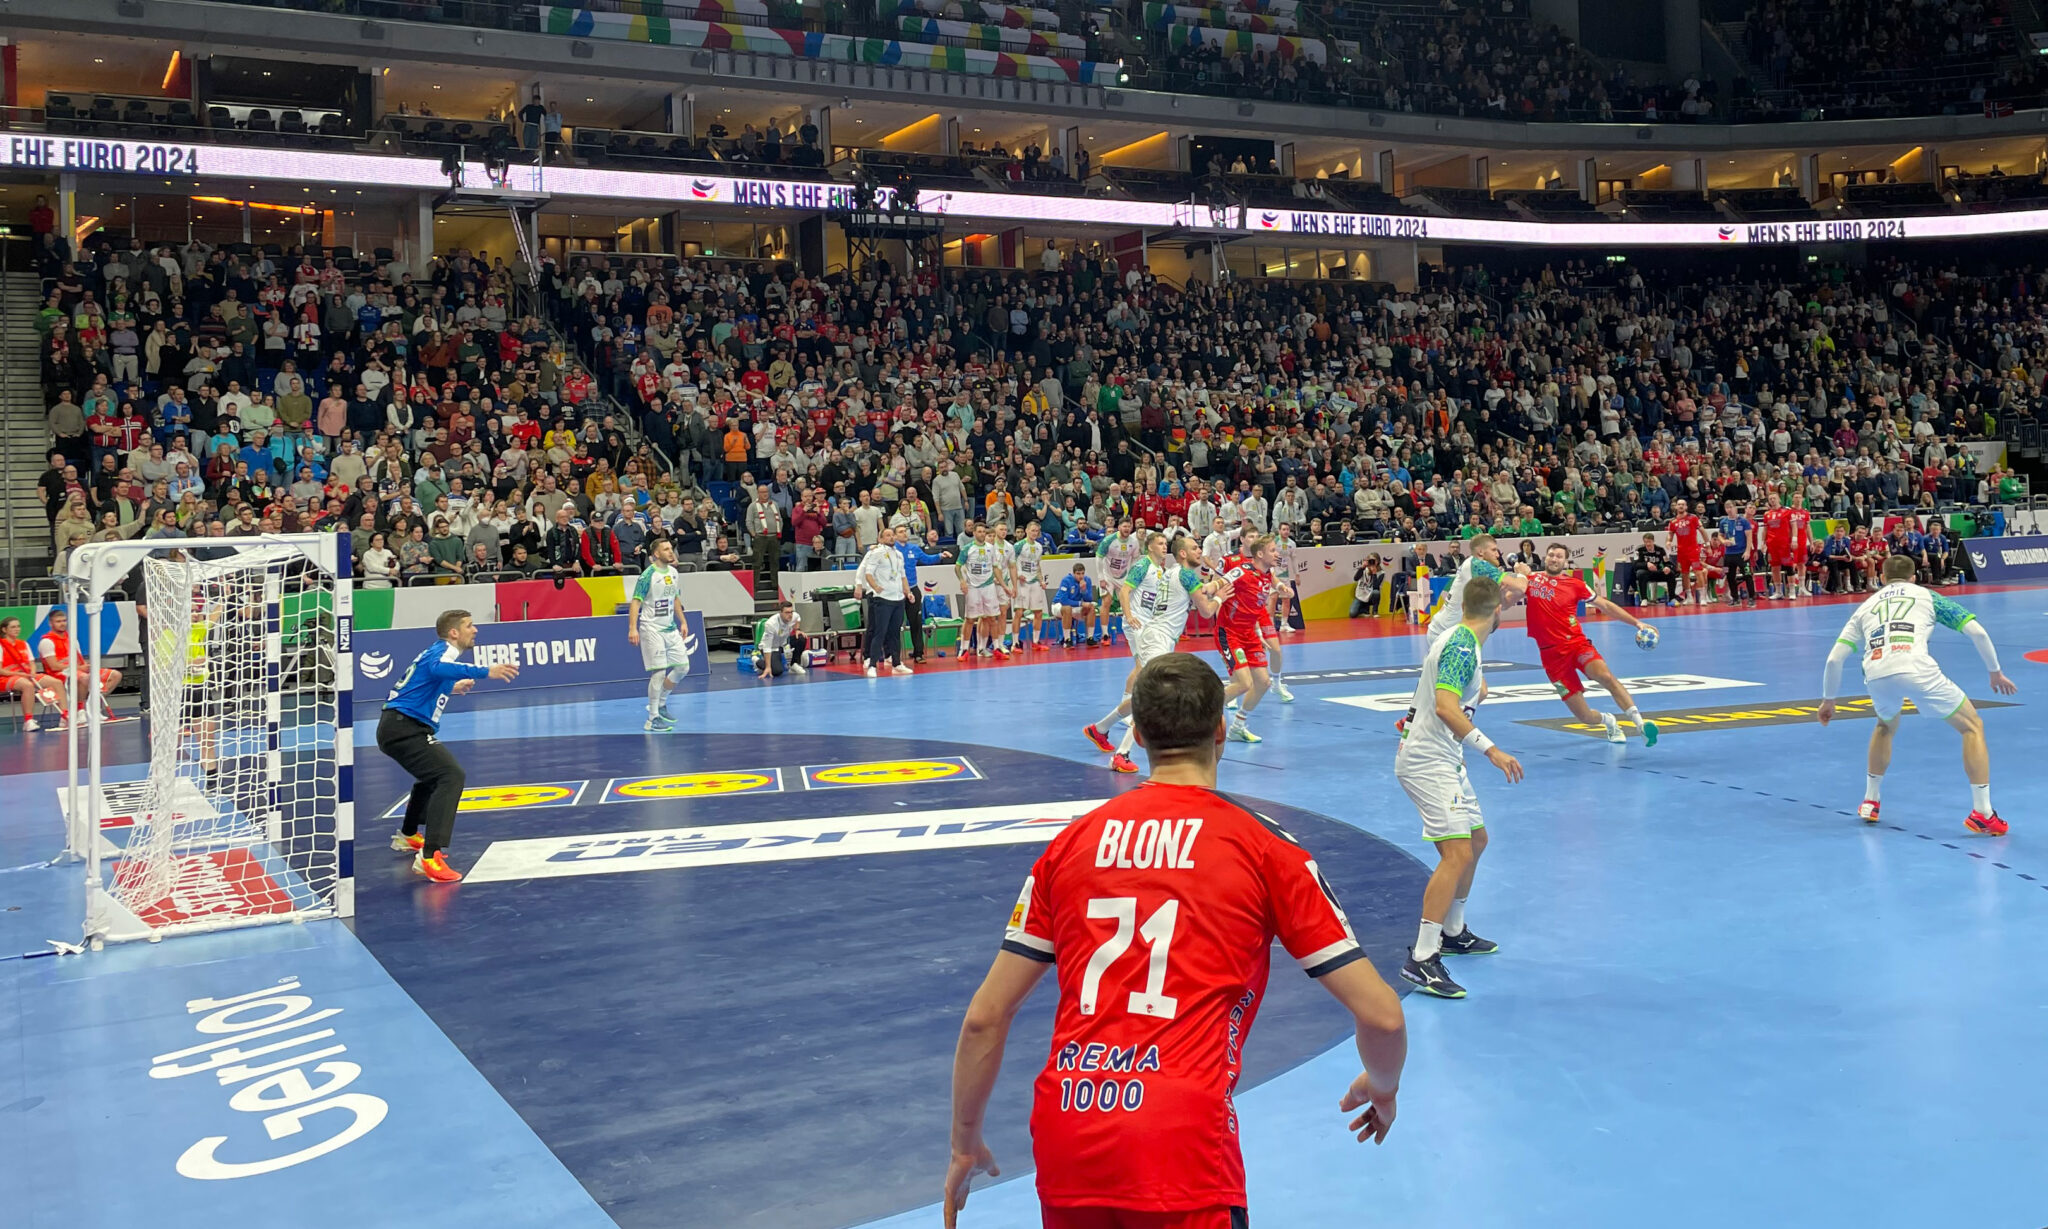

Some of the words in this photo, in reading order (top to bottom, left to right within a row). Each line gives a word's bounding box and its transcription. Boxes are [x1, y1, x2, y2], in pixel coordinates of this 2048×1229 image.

[11, 136, 54, 168] EHF
[63, 140, 127, 173] EURO
[135, 144, 199, 177] 2024
[733, 181, 787, 208] MEN'S
[792, 186, 823, 210] EHF
[1291, 212, 1330, 235] MEN'S
[1334, 214, 1356, 235] EHF
[1361, 216, 1391, 238] EURO
[1396, 218, 1428, 240] 2024
[1748, 224, 1791, 244] MEN'S
[1796, 223, 1821, 242] EHF
[1825, 221, 1862, 242] EURO
[1867, 219, 1906, 240] 2024
[1871, 596, 1916, 624] 17
[473, 643, 521, 667] HERE
[523, 642, 550, 665] TO
[552, 638, 597, 664] PLAY
[568, 833, 706, 849] TYRES
[1095, 818, 1203, 869] BLONZ
[1080, 897, 1179, 1019] 71
[1228, 988, 1255, 1064] REMA
[1057, 1041, 1160, 1072] REMA
[1061, 1078, 1144, 1112] 1000
